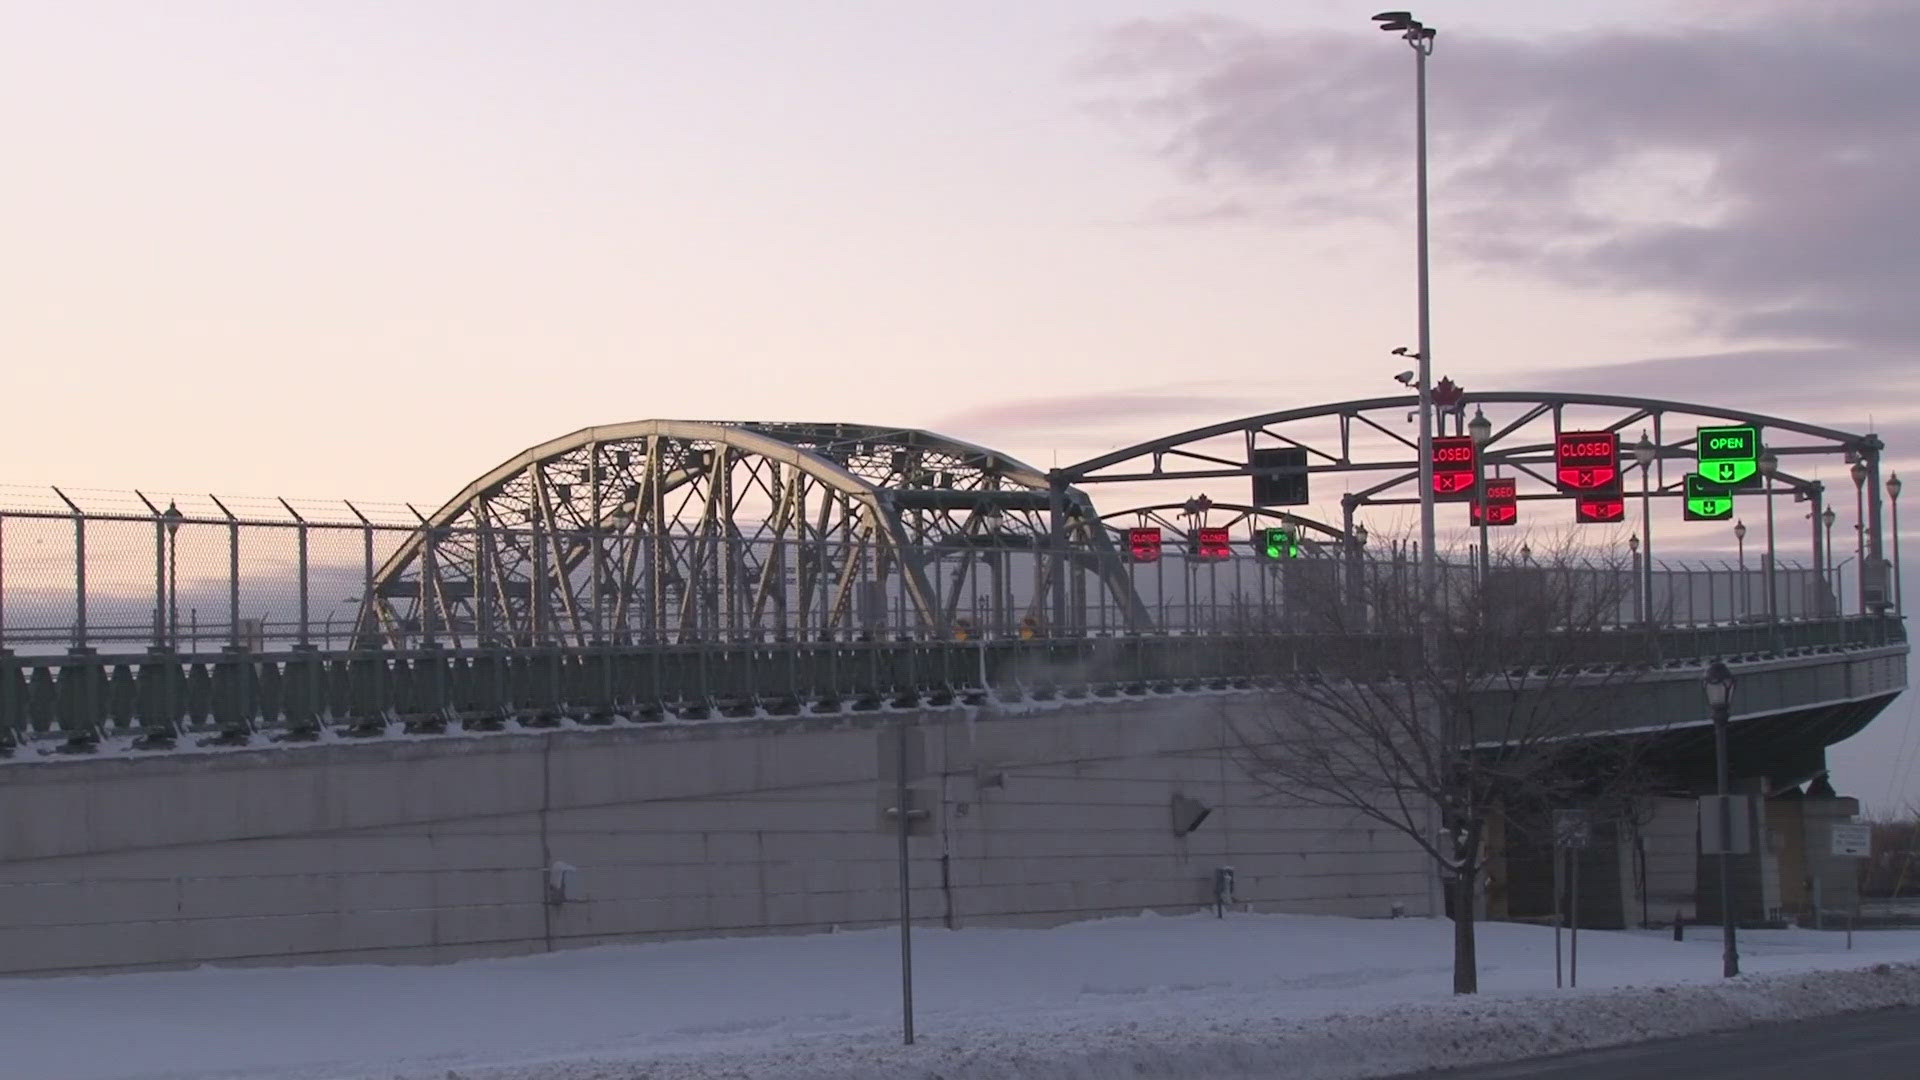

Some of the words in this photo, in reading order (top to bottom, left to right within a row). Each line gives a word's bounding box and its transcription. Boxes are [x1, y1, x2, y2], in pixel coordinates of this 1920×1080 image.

[1562, 443, 1610, 457] CLOSED
[1709, 437, 1743, 450] OPEN
[1432, 447, 1471, 462] LOSED
[1487, 486, 1513, 498] OSED
[1272, 533, 1288, 542] OPE
